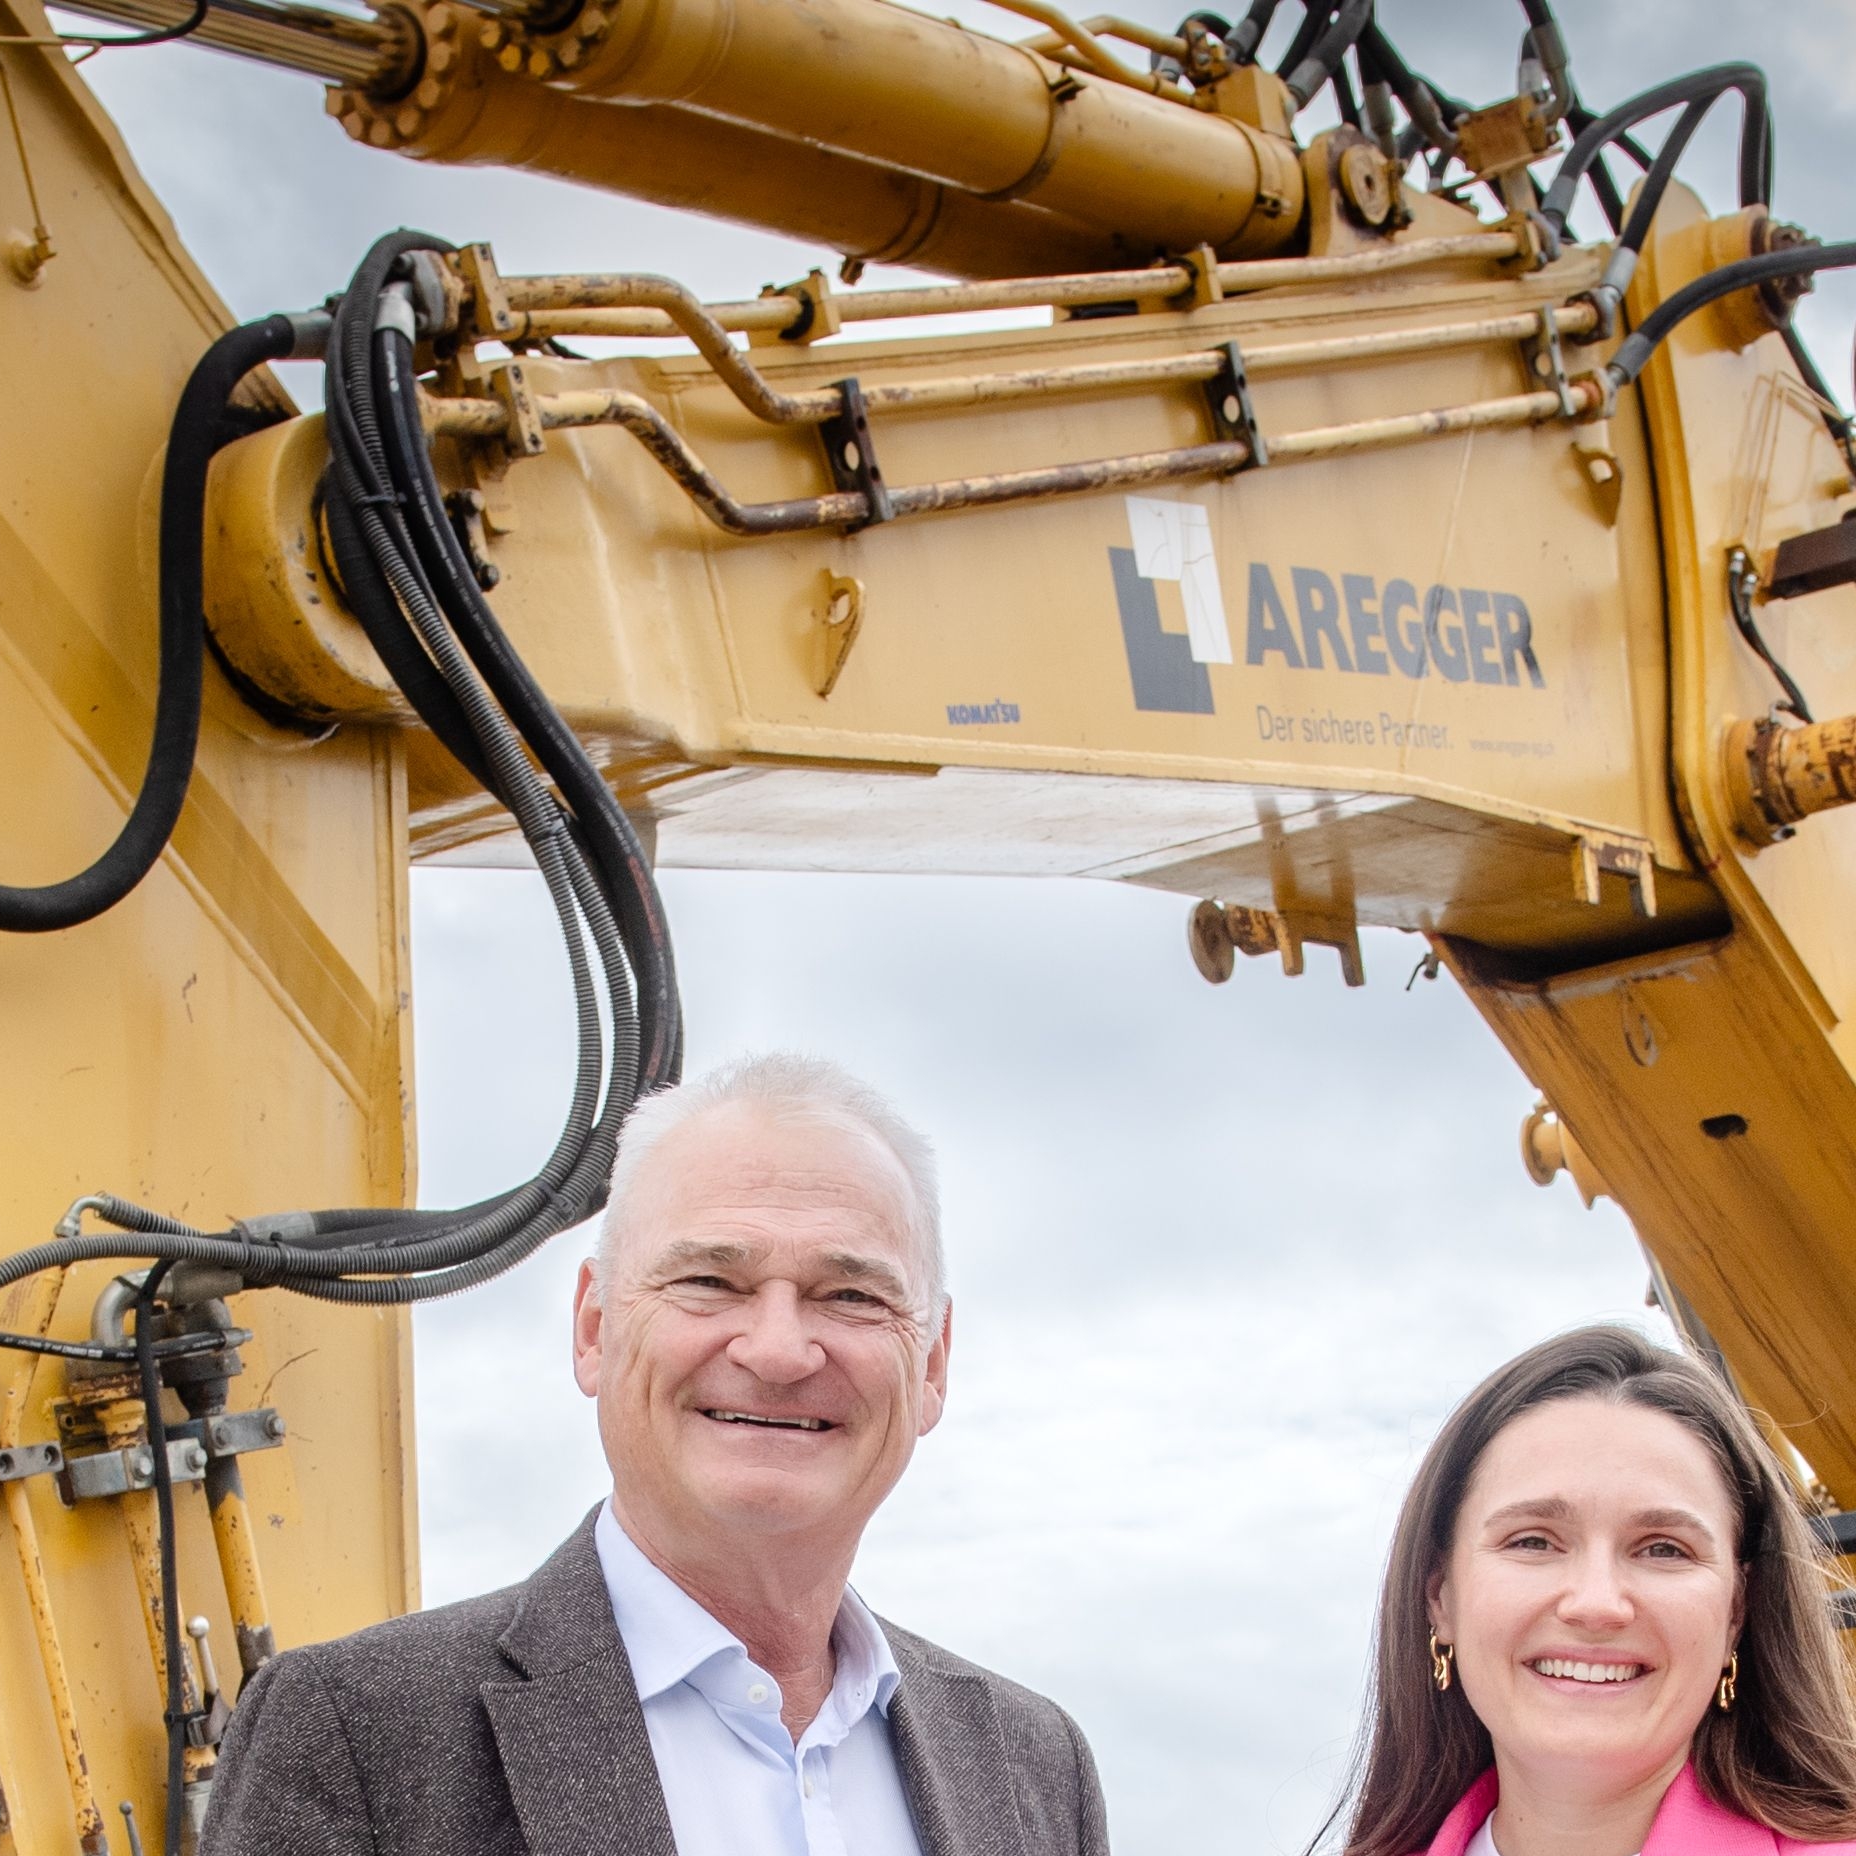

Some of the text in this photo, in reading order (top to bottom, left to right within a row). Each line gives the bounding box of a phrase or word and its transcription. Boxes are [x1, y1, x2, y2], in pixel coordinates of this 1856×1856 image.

[1245, 561, 1546, 690] AREGGER
[945, 697, 1021, 726] KOMATSU
[1255, 704, 1294, 742] Der
[1301, 710, 1376, 747] sichere
